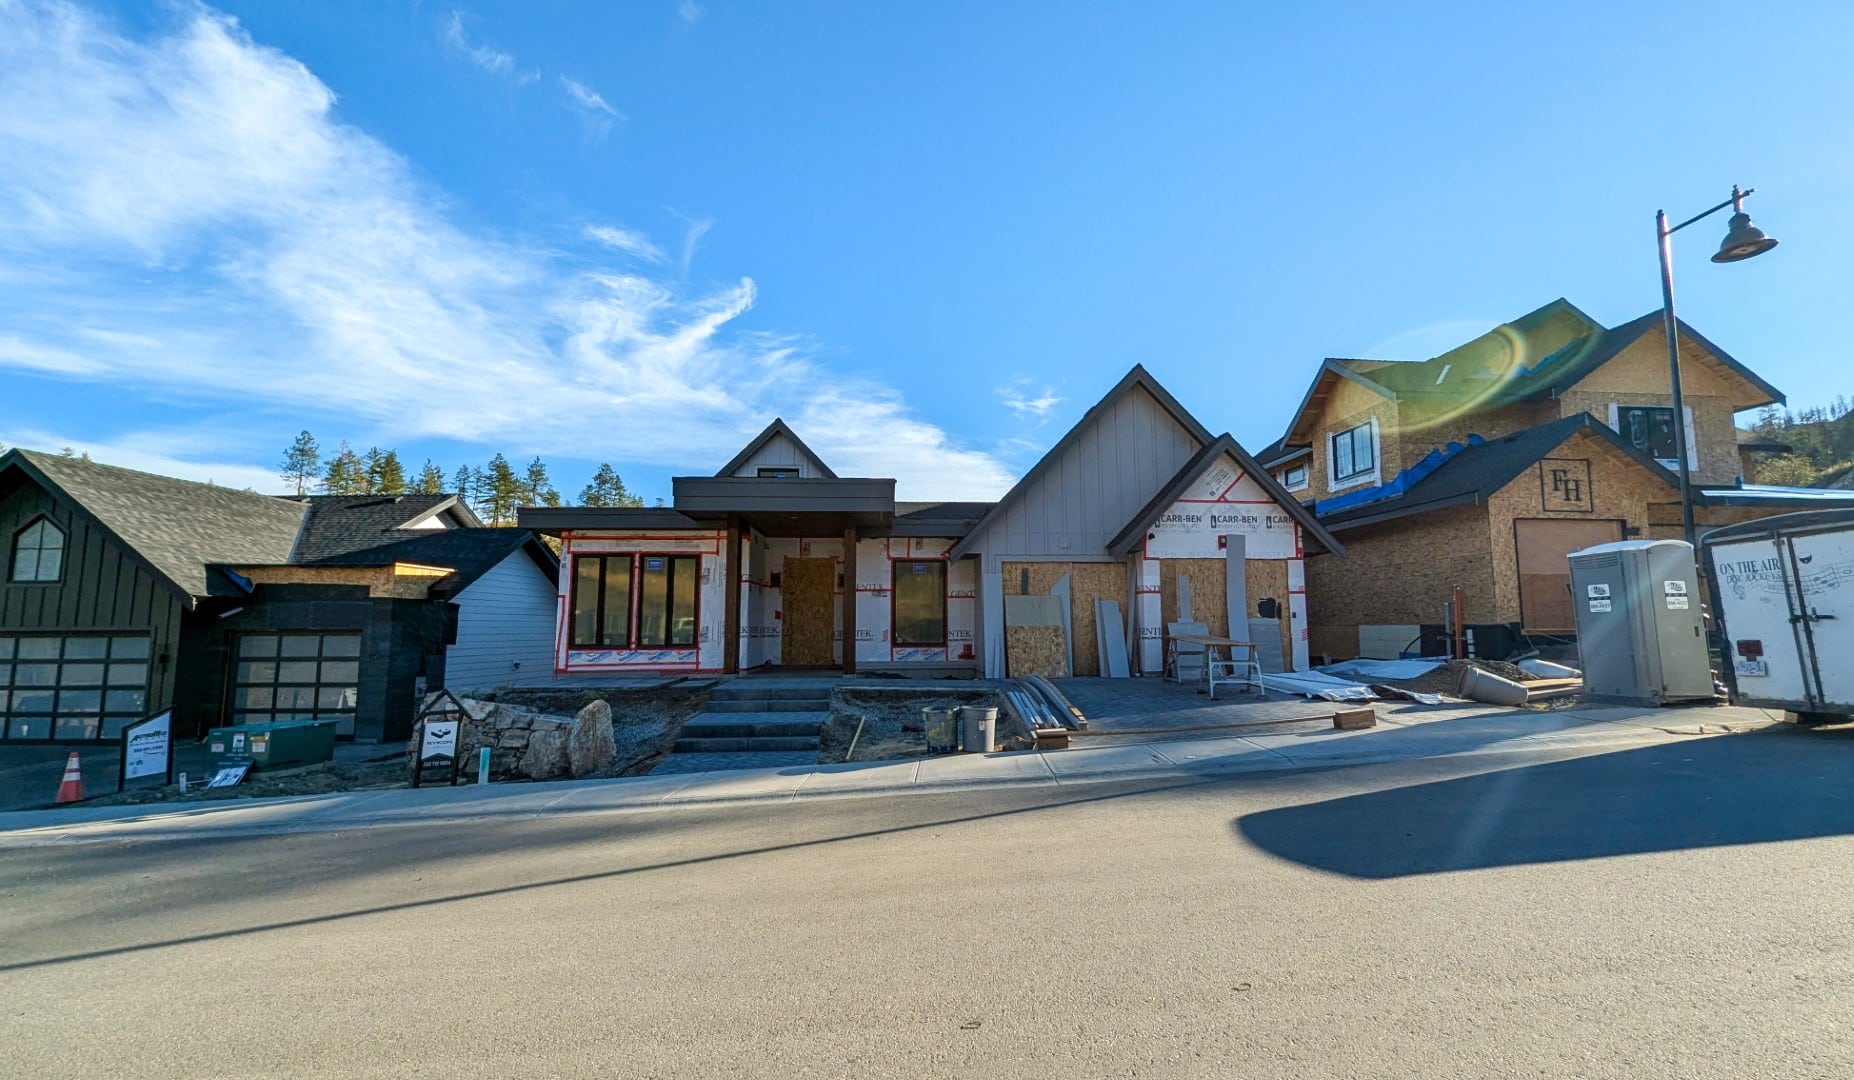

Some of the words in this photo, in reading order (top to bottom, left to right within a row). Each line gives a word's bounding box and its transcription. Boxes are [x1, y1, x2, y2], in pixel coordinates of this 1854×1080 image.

[1160, 514, 1202, 523] CARR-BEN
[1217, 515, 1258, 524] CARR-BEN
[1719, 562, 1735, 576] ON
[1736, 560, 1758, 574] THE
[1761, 558, 1781, 572] AIR
